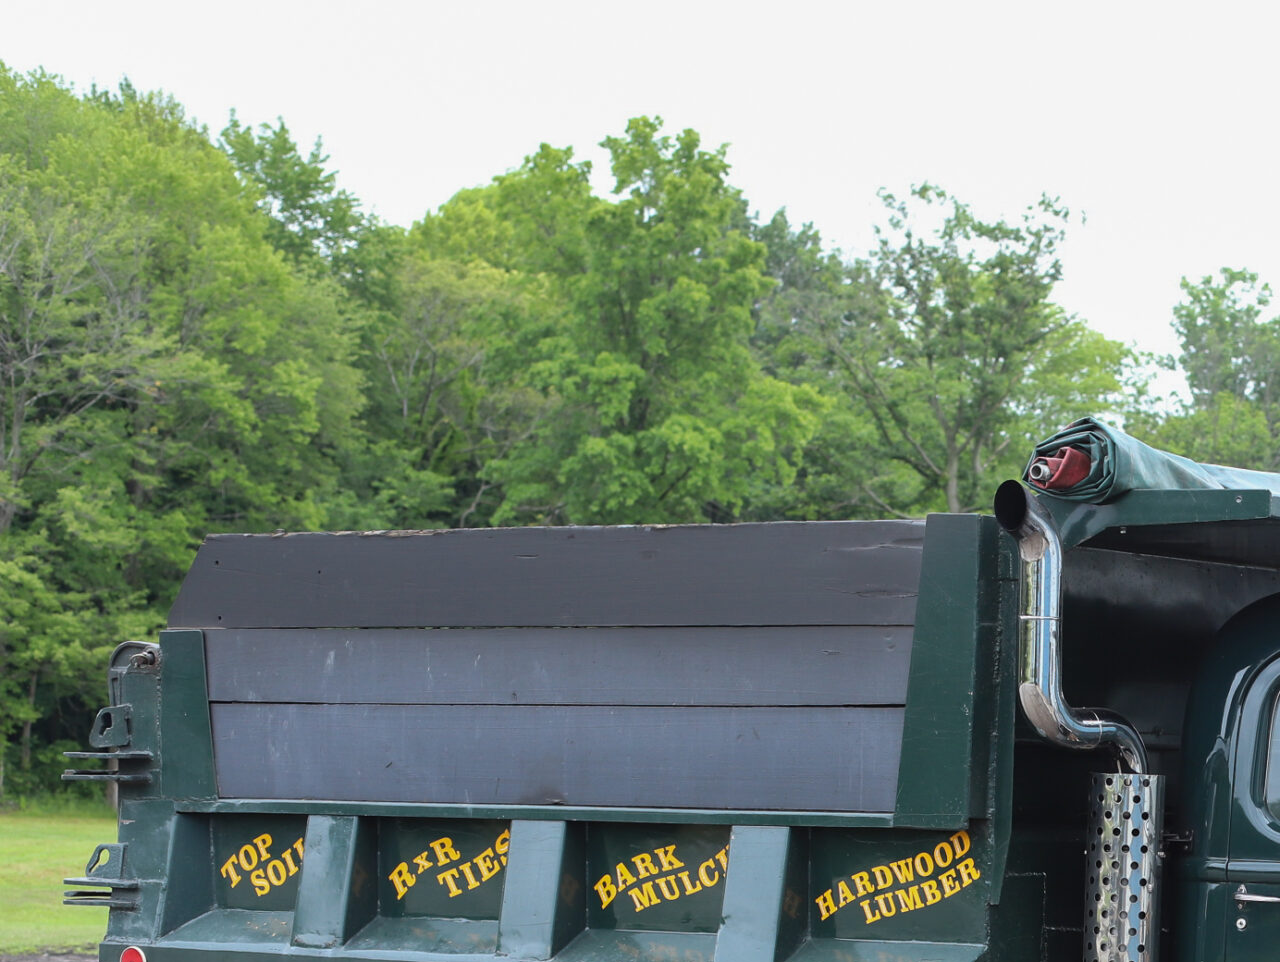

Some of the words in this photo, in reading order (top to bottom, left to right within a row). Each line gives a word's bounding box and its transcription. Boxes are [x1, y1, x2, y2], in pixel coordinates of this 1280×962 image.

[220, 833, 274, 889] TOP
[594, 844, 685, 910] BARK
[815, 830, 972, 921] HARDWOOD
[860, 857, 982, 925] LUMBER
